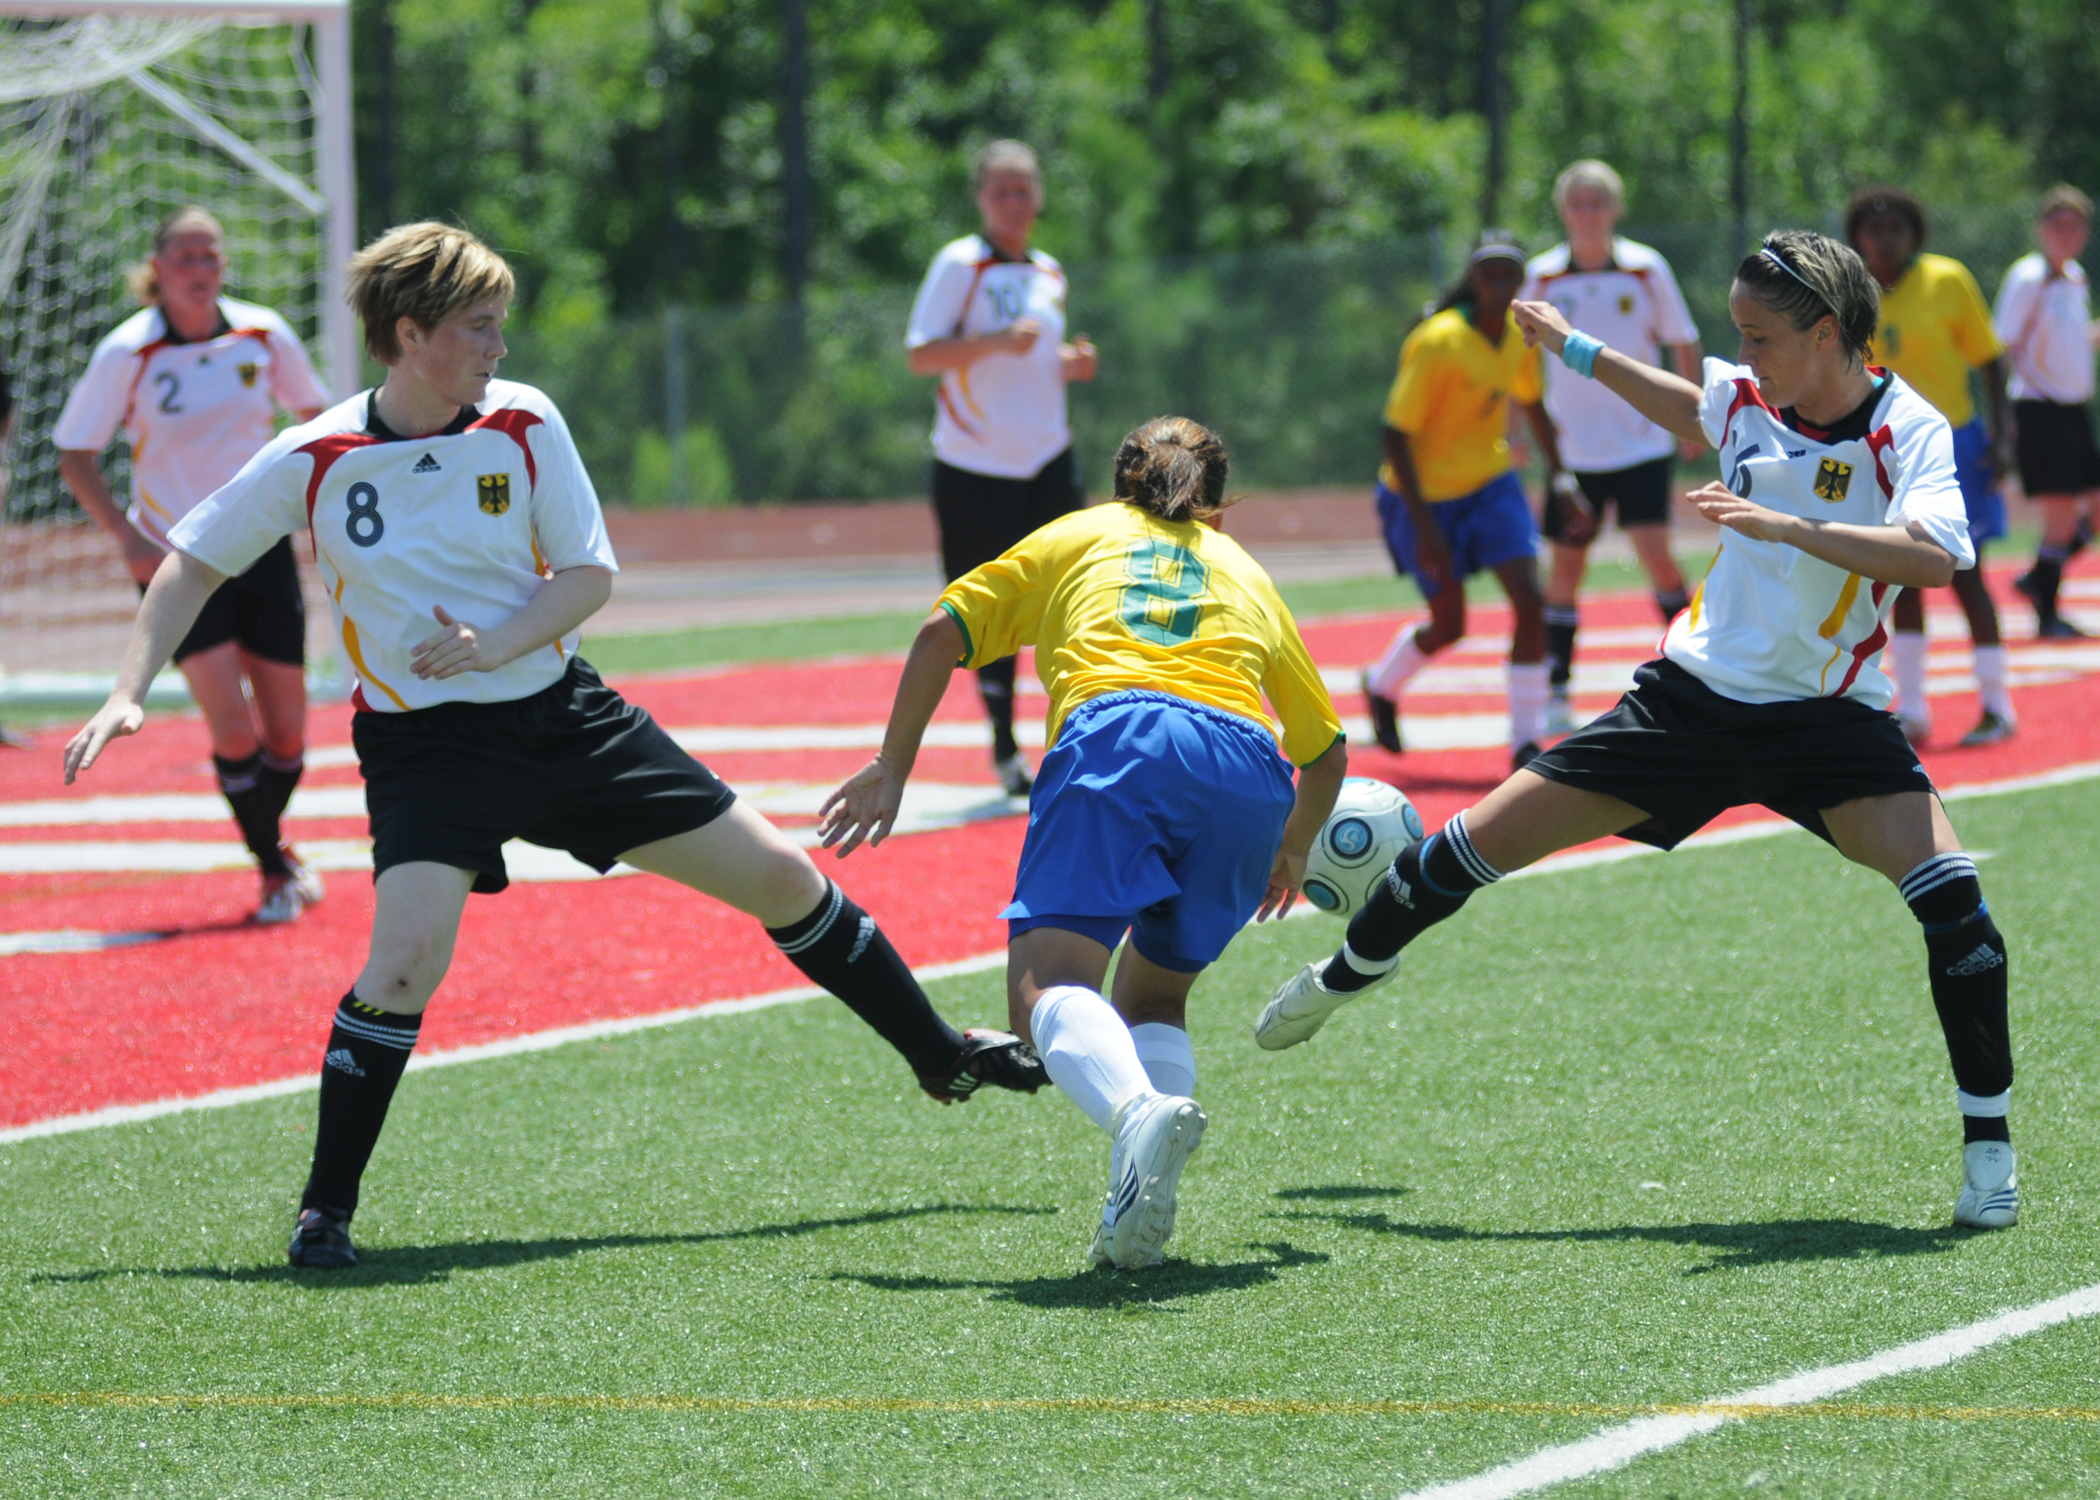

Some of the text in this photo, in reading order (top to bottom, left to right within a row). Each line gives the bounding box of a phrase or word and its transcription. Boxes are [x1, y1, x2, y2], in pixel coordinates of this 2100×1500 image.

[986, 284, 1023, 321] 10
[154, 370, 184, 414] 2
[412, 464, 442, 475] adidas
[346, 481, 384, 548] 8
[1115, 536, 1211, 647] 8
[1946, 953, 2004, 977] adidas
